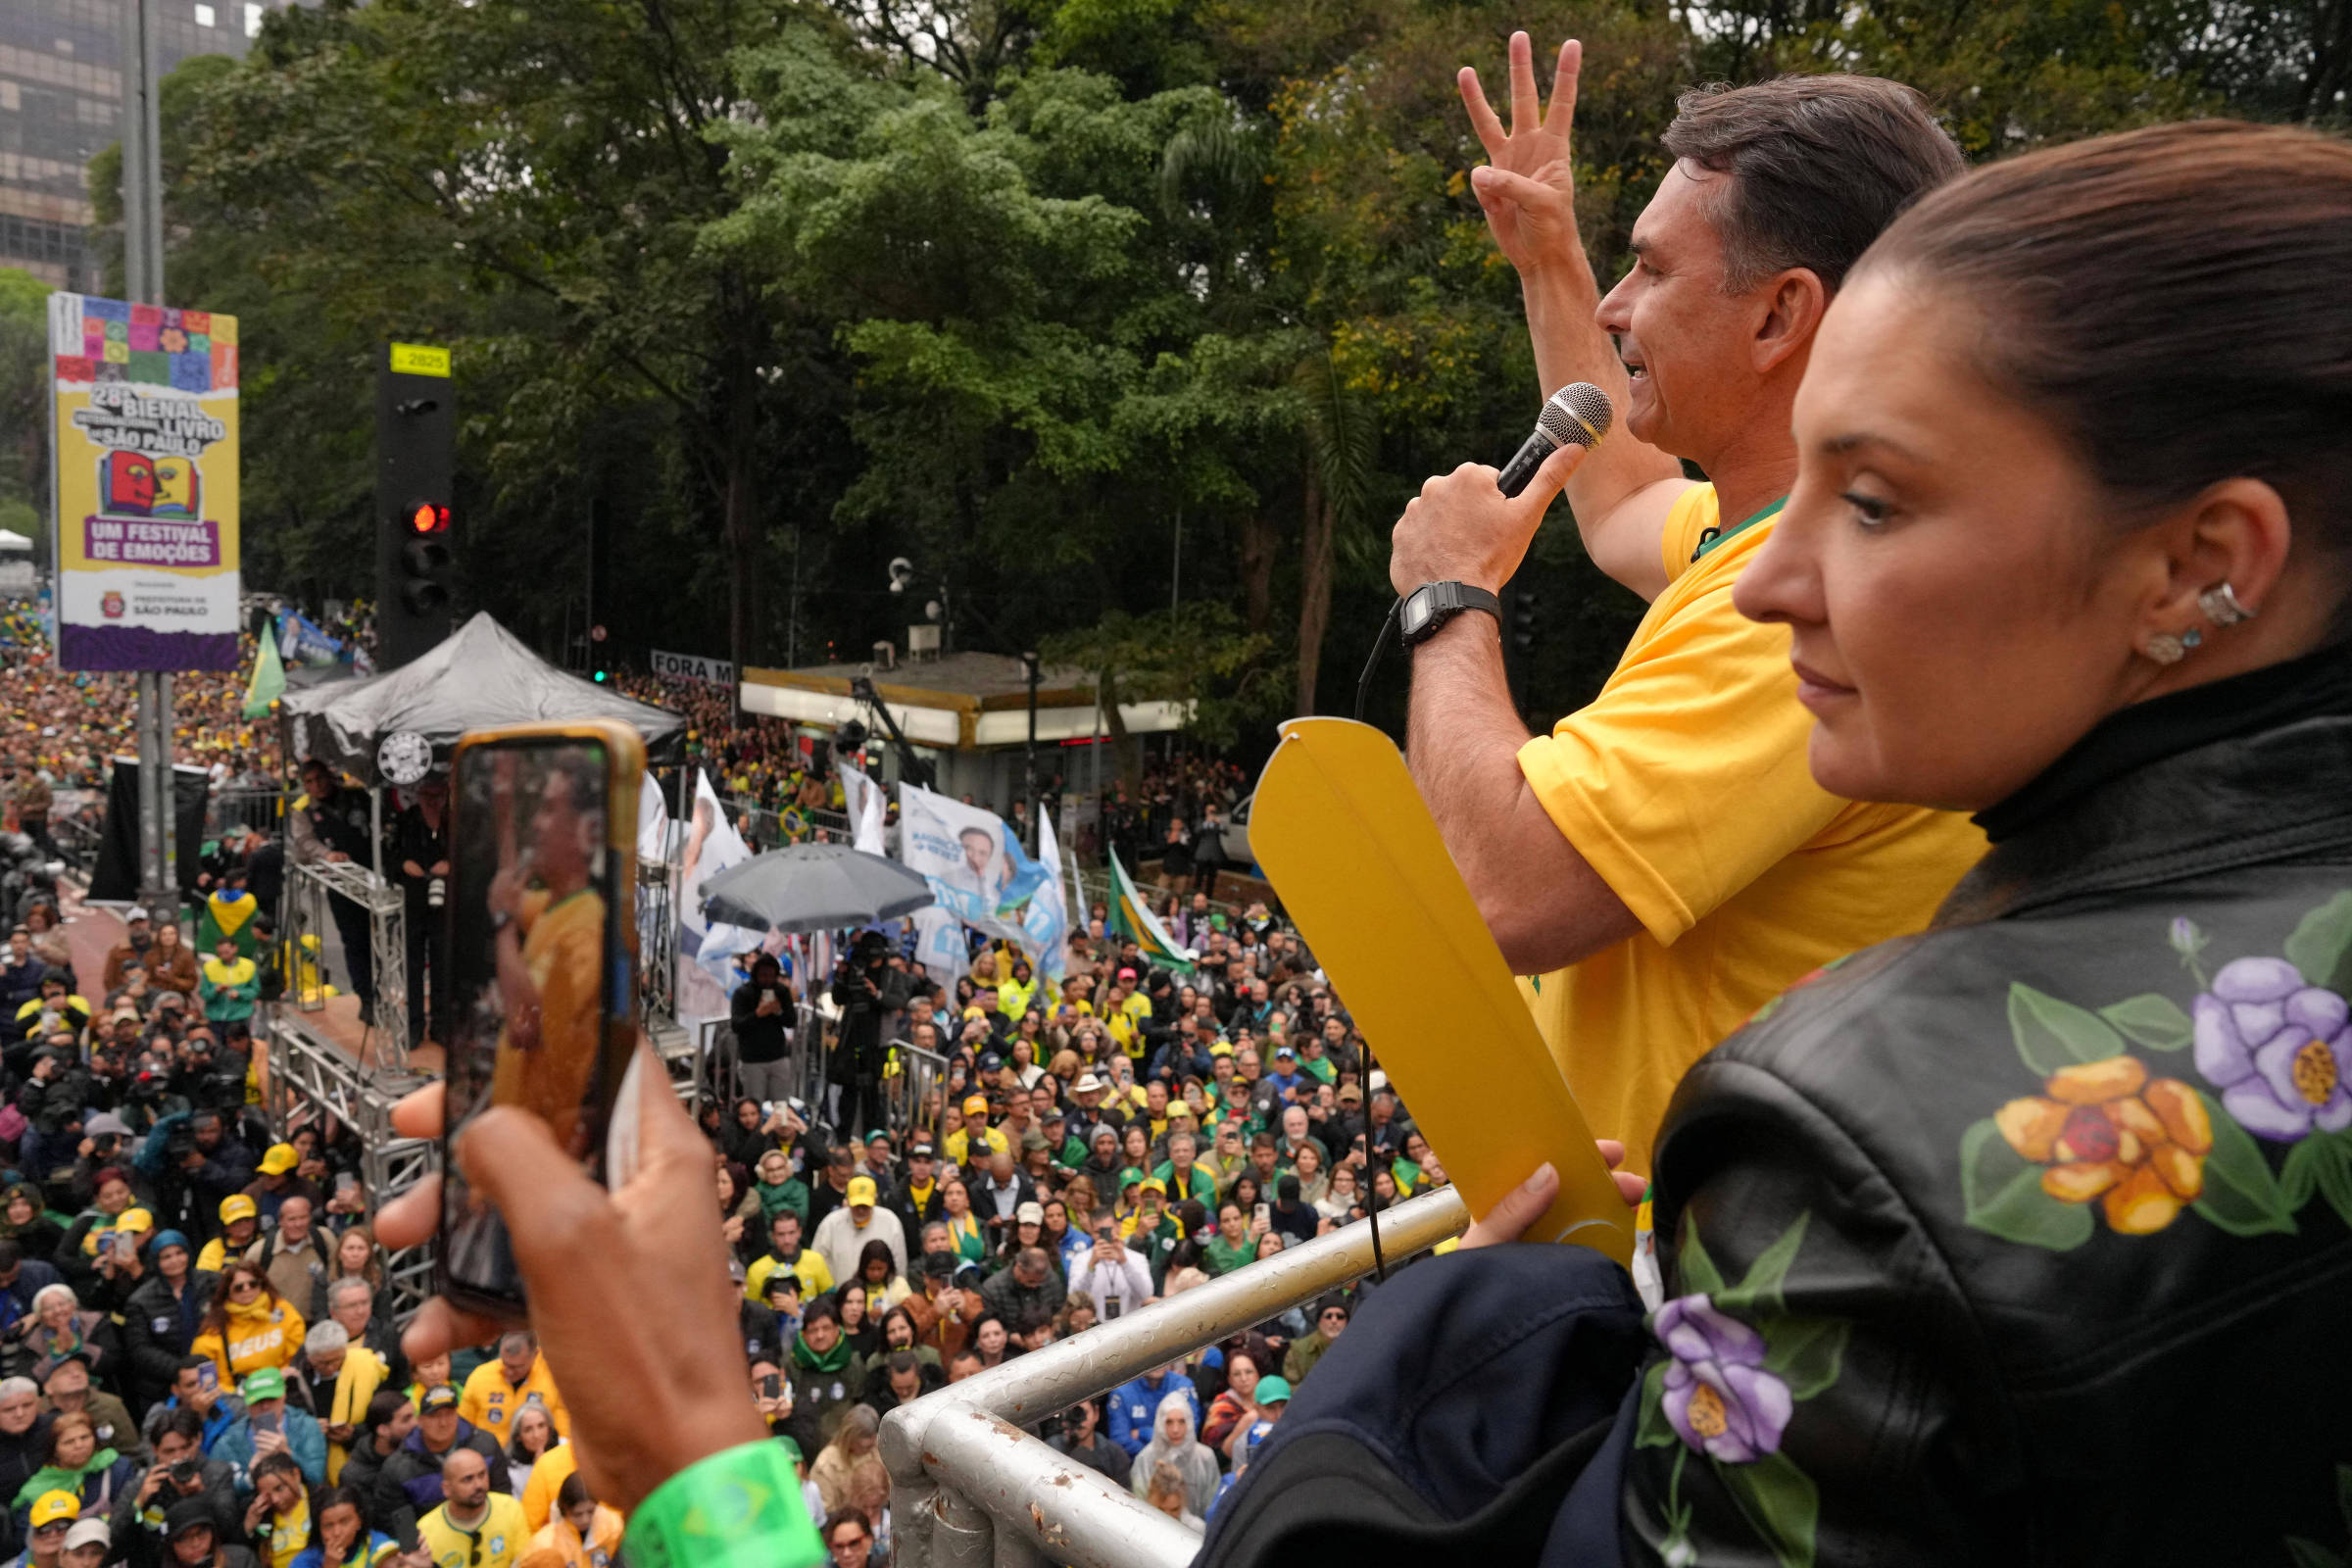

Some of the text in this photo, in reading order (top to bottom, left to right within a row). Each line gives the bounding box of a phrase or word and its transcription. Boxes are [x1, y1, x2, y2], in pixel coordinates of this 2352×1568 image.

[409, 353, 444, 368] 2825
[122, 398, 202, 419] BIENAL
[102, 425, 140, 447] SÃO
[142, 434, 201, 455] PAULO
[164, 418, 224, 440] LIVRO
[91, 521, 212, 544] UM FESTIVAL
[93, 541, 212, 565] DE EMOÇÕES
[134, 605, 208, 616] SÃO PAULO
[655, 653, 708, 679] FORA
[228, 1327, 283, 1362] DEUS
